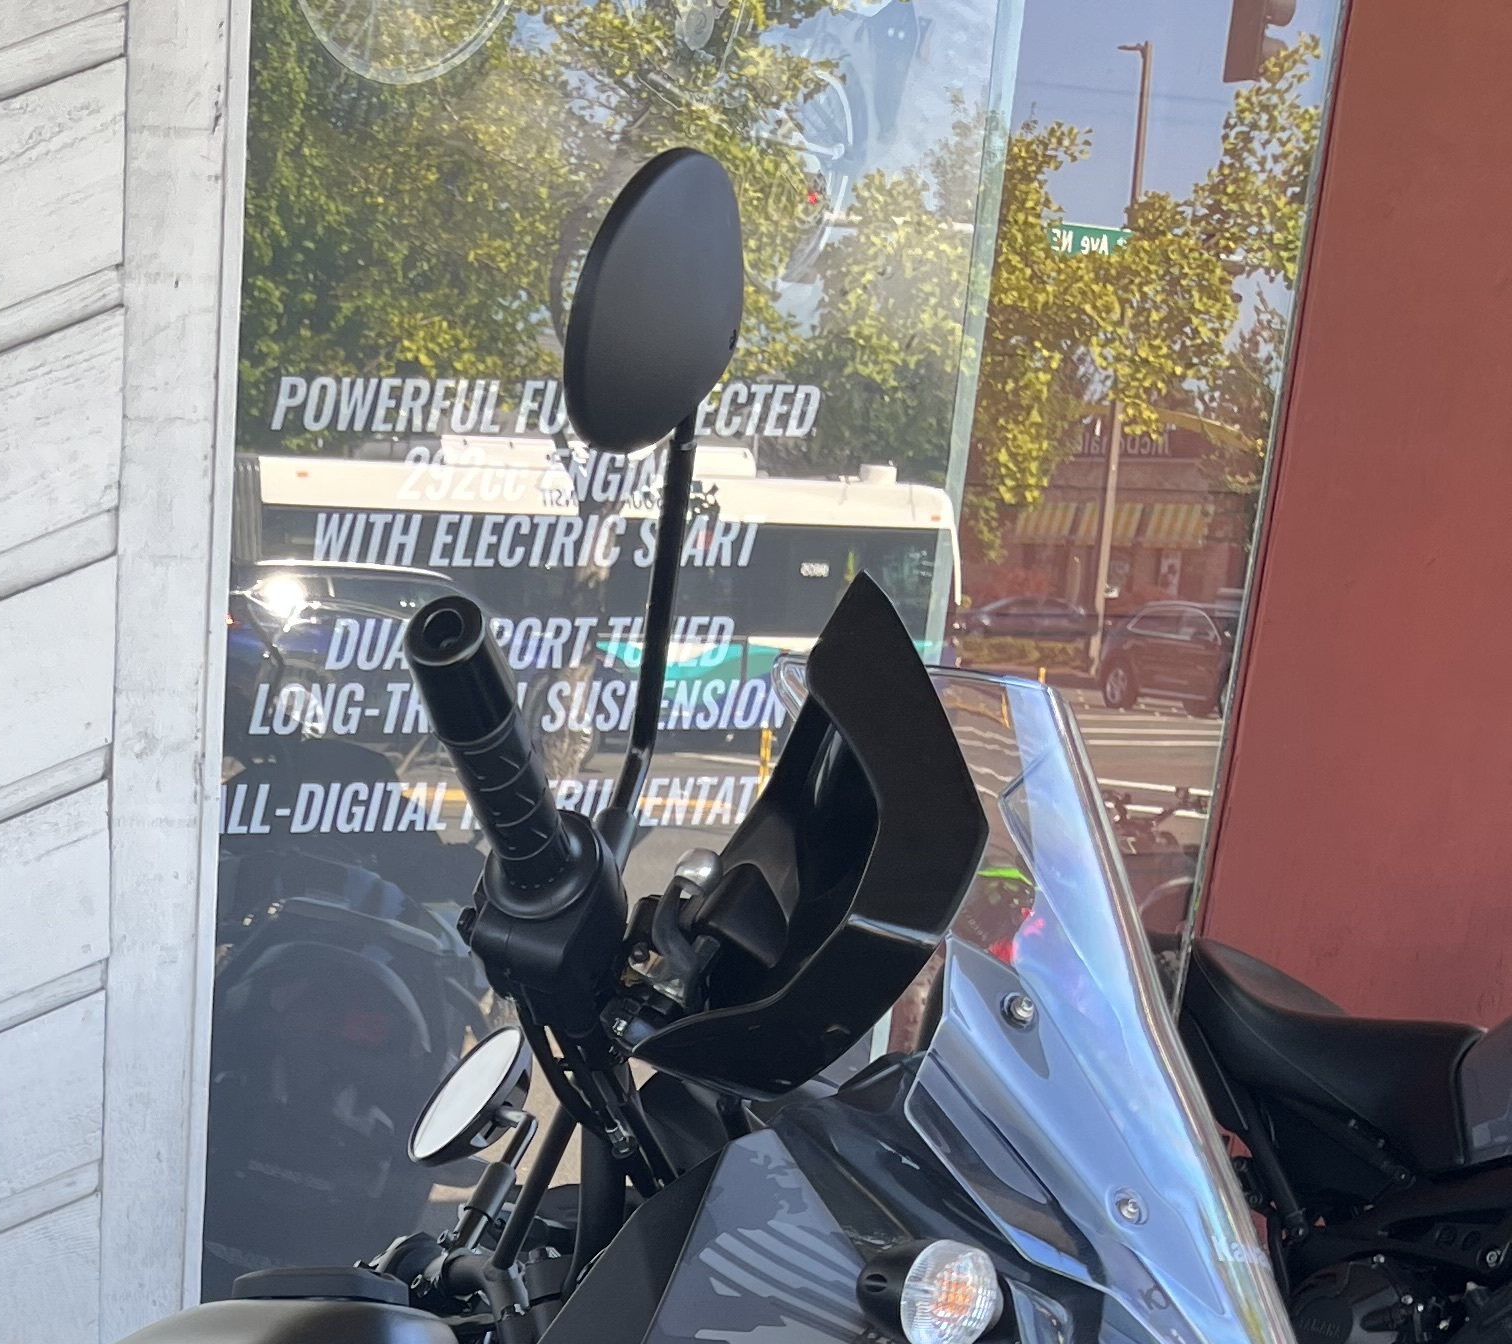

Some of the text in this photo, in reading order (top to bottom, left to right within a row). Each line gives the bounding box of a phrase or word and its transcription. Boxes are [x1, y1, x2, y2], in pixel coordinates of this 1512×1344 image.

[270, 376, 501, 434] POWERFUL
[312, 512, 759, 568] WITH ELECTRIC SART
[603, 615, 735, 668] TUED
[1211, 1234, 1274, 1270] Kawa
